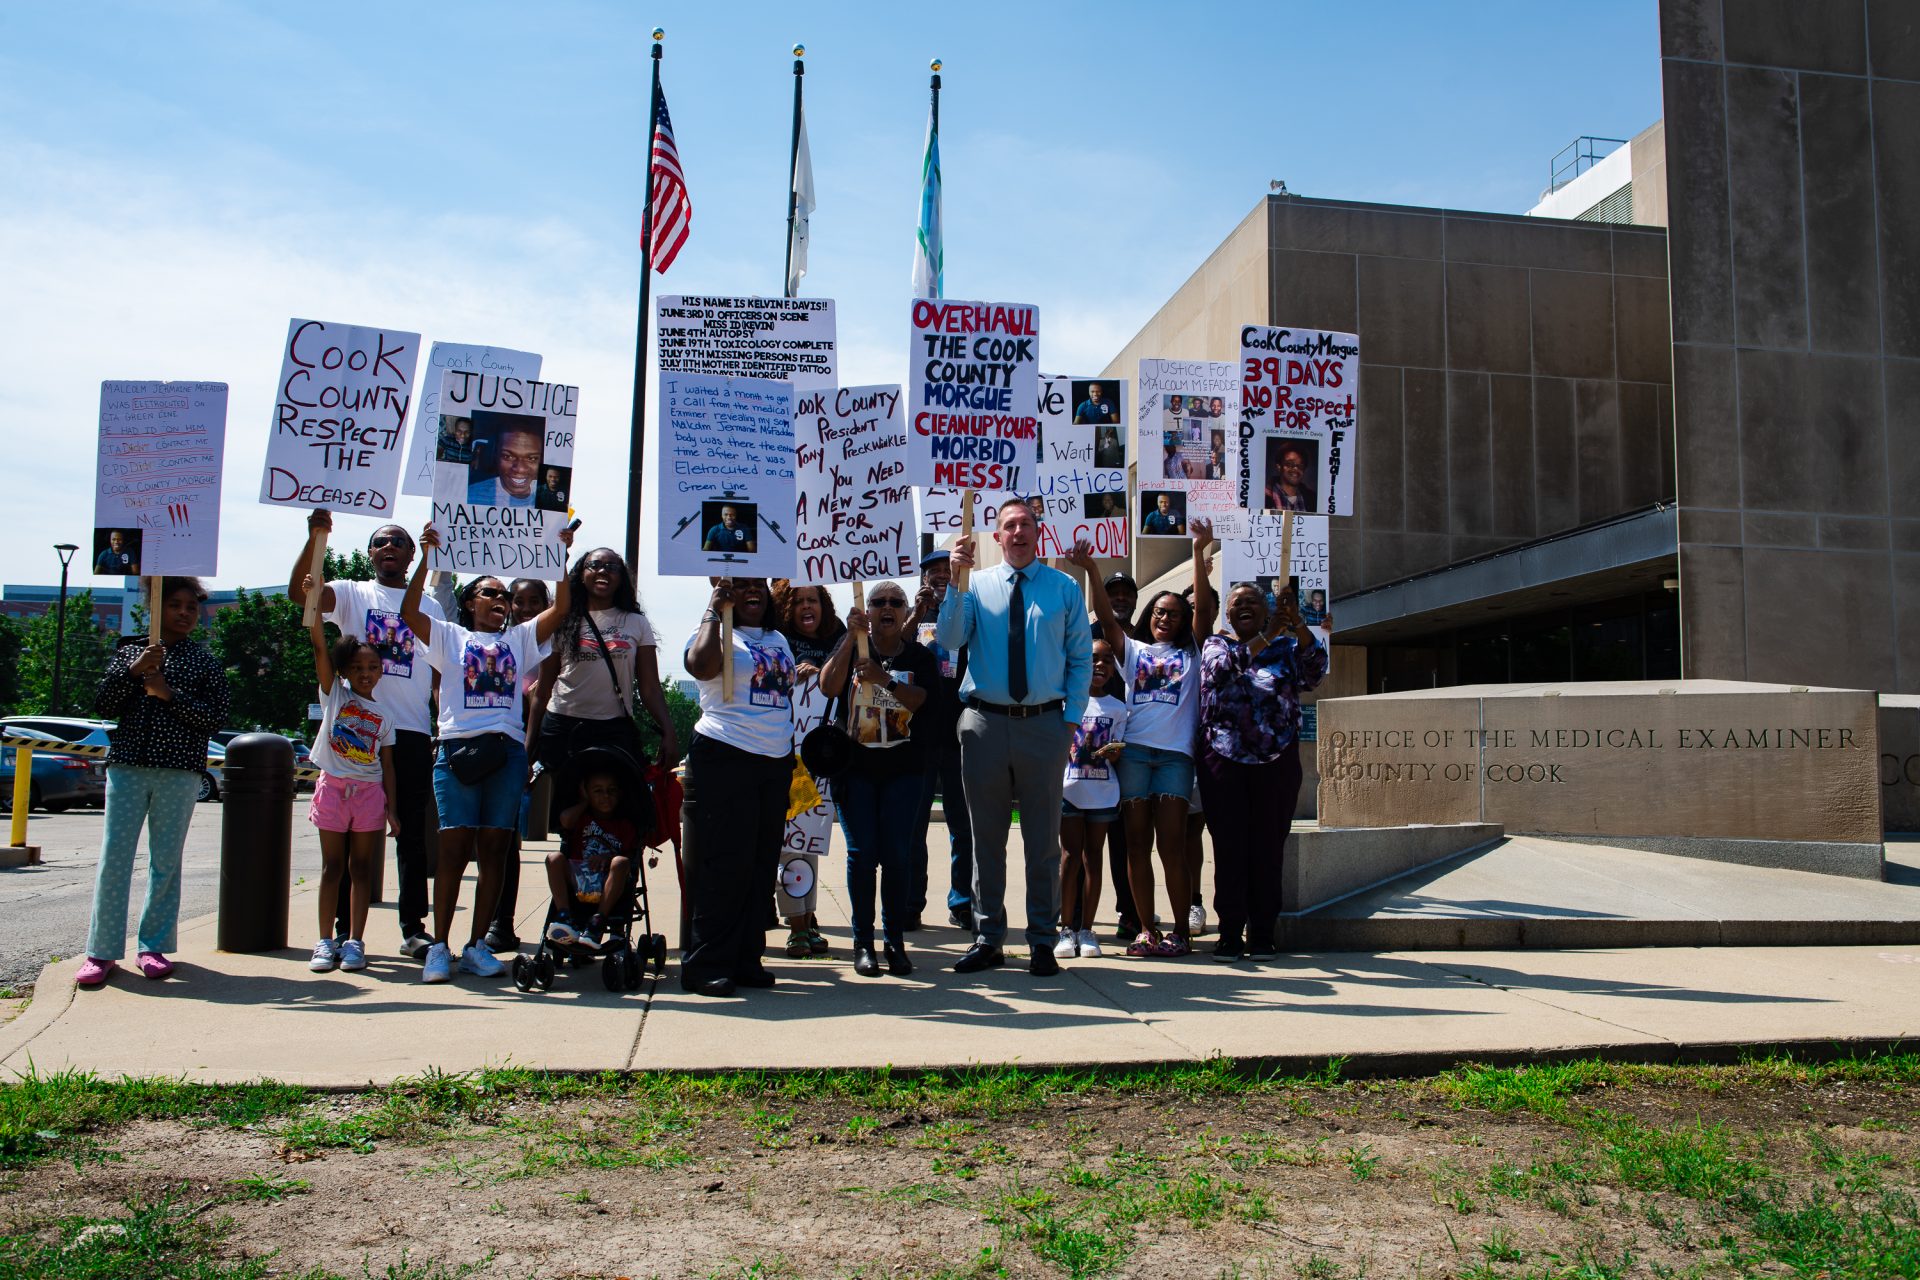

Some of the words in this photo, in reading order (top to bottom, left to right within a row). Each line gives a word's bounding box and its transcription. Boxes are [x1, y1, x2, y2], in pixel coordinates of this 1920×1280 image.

[682, 296, 700, 307] HIS
[704, 298, 732, 308] NAME
[734, 298, 745, 308] IS
[748, 299, 784, 310] KELVIN
[792, 301, 828, 311] DAVIS!!
[660, 308, 686, 318] JUNE
[686, 310, 704, 318] 3RD
[705, 310, 714, 318] 10
[718, 310, 762, 320] OFFICERS
[763, 312, 777, 320] ON
[780, 312, 808, 322] SCENE
[704, 320, 727, 329] MISS
[730, 320, 741, 330] ID
[912, 300, 1037, 336] OVERHAUL
[659, 328, 686, 338] JUNE
[687, 328, 706, 338] 4TH
[708, 329, 754, 338] AUTOPSY
[290, 321, 406, 384] COOK
[659, 338, 686, 348] JUNE
[688, 338, 710, 348] 19TH
[714, 340, 780, 349] TOXICOLOGY
[783, 341, 833, 350] COMPLETE
[924, 334, 966, 358] THE
[973, 337, 1034, 362] COOK
[1318, 334, 1358, 360] Morgue
[432, 348, 473, 368] Cook
[660, 349, 684, 358] JULY
[686, 350, 704, 358] 9TH
[706, 350, 752, 360] MISSING
[754, 352, 798, 362] PERSONS
[800, 354, 827, 363] FILED
[660, 359, 682, 368] JULY
[702, 360, 740, 370] MOTHER
[742, 361, 796, 372] IDENTIFIED
[798, 364, 832, 374] TATTOO
[748, 371, 788, 380] MORGUE
[925, 359, 1017, 388] COUNTY
[1146, 358, 1203, 380] Justice
[1209, 362, 1232, 377] For
[1244, 358, 1281, 386] 39
[1286, 359, 1344, 388] DAYS
[450, 370, 579, 416] JUSTICE
[1140, 378, 1189, 391] MALCOLM
[795, 392, 826, 420] OOK
[835, 388, 900, 419] COUNTY
[924, 382, 1014, 412] MORGUE
[1242, 385, 1272, 408] NO
[284, 370, 409, 451] COUNTY
[1241, 407, 1266, 420] The
[1274, 410, 1312, 430] FOR
[277, 404, 397, 450] RESPECT
[1325, 417, 1354, 432] Their
[546, 431, 574, 448] FOR
[309, 442, 375, 471] THE
[932, 436, 1016, 465] MORBID
[1050, 441, 1094, 462] Want
[266, 467, 387, 510] DECEASED
[830, 465, 852, 499] You
[868, 461, 904, 485] NEED
[1013, 469, 1124, 499] ustice
[1138, 481, 1148, 490] He
[1150, 480, 1166, 489] had
[433, 502, 544, 527] MALCOLM
[796, 491, 807, 525] A
[818, 493, 852, 517] NEW
[1047, 496, 1076, 517] FOR
[832, 512, 873, 533] FOR
[448, 526, 543, 542] JERMAINE
[797, 532, 840, 550] COOK
[804, 550, 914, 582] MORGUE
[1300, 576, 1322, 588] FOR
[1330, 730, 1416, 749] OFFICE
[1423, 730, 1455, 749] OF
[1464, 729, 1517, 748] THE
[1530, 728, 1663, 749] MEDICAL
[1678, 728, 1860, 750] EXAMINER
[1331, 763, 1438, 782] COUNTY
[1444, 763, 1476, 783] OF
[1487, 764, 1566, 784] COOK
